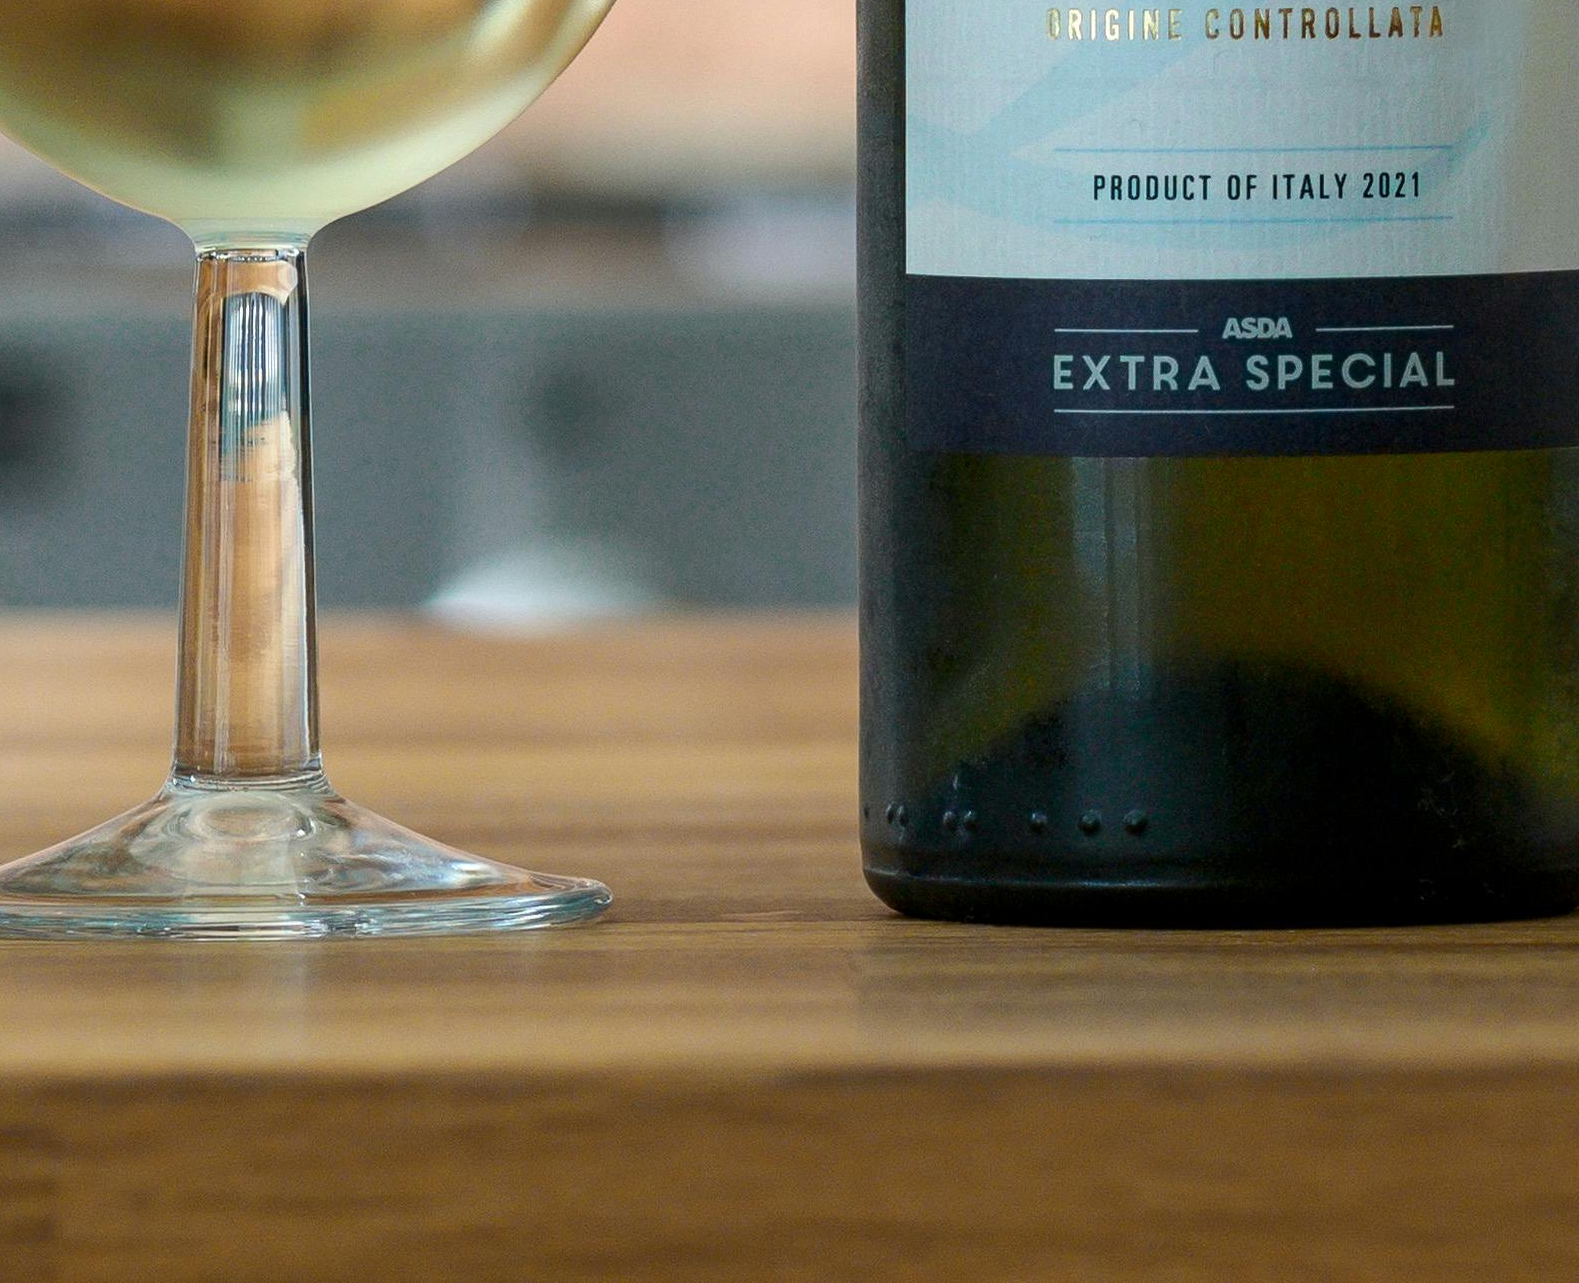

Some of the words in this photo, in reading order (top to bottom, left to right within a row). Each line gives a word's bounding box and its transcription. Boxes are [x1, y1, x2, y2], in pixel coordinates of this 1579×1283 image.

[1045, 7, 1183, 41] ORIGINE
[1204, 5, 1444, 40] CONTROLLATA
[1093, 174, 1212, 201] PRODUCT
[1226, 173, 1258, 201] OF
[1272, 172, 1348, 200] ITALY
[1362, 170, 1421, 199] 2021
[1221, 316, 1294, 340] ASDA
[1053, 353, 1221, 392] EXTRA
[1245, 350, 1456, 392] SPECIAL
